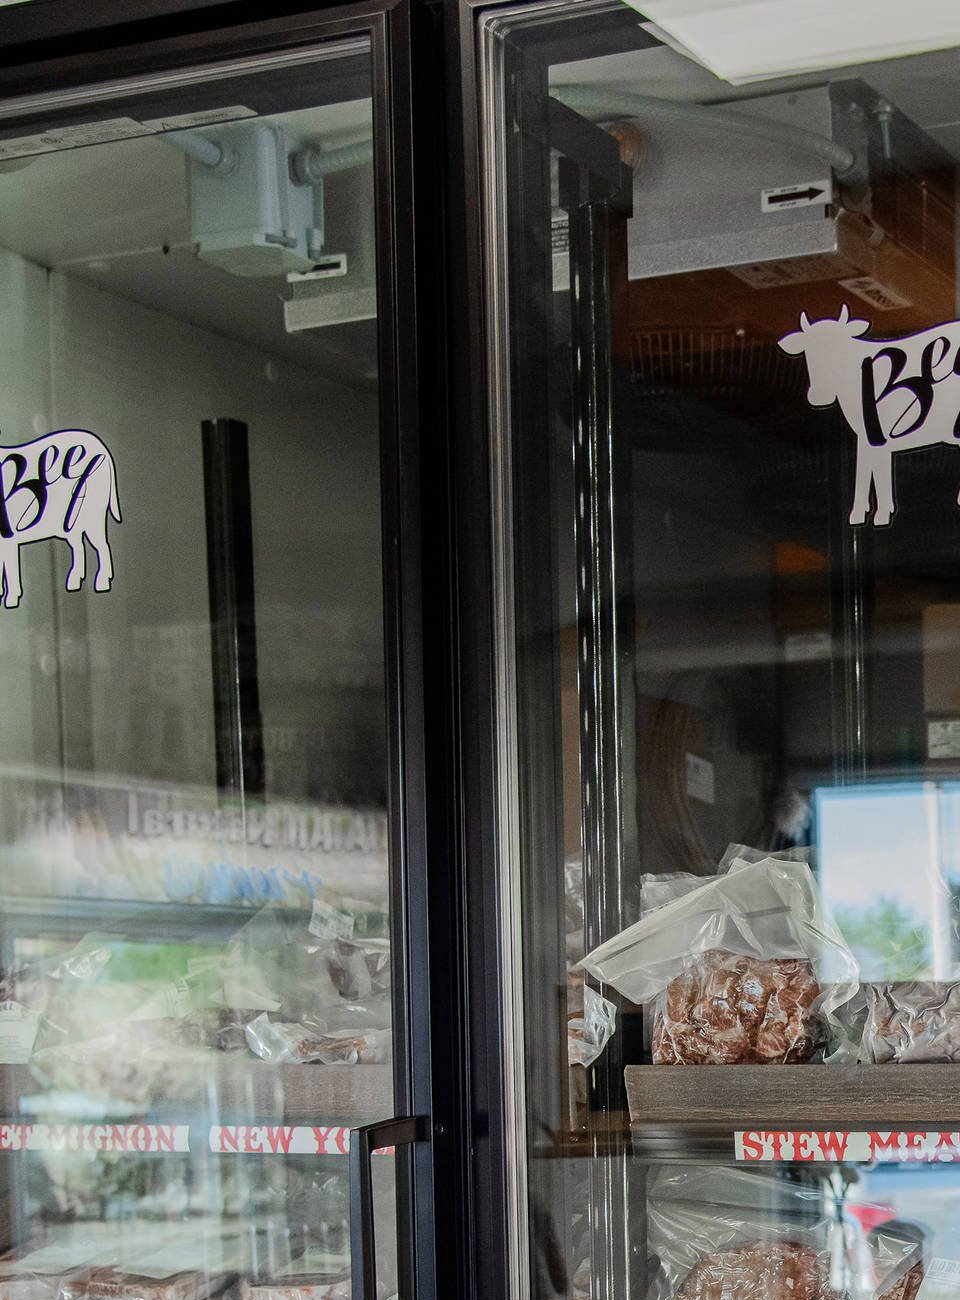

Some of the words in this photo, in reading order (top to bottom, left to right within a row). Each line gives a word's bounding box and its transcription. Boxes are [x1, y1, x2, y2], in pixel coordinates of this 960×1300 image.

[0, 444, 106, 539] Beef
[49, 1125, 177, 1152] MIGNON
[219, 1127, 295, 1154] NEW
[742, 1132, 849, 1161] STEW
